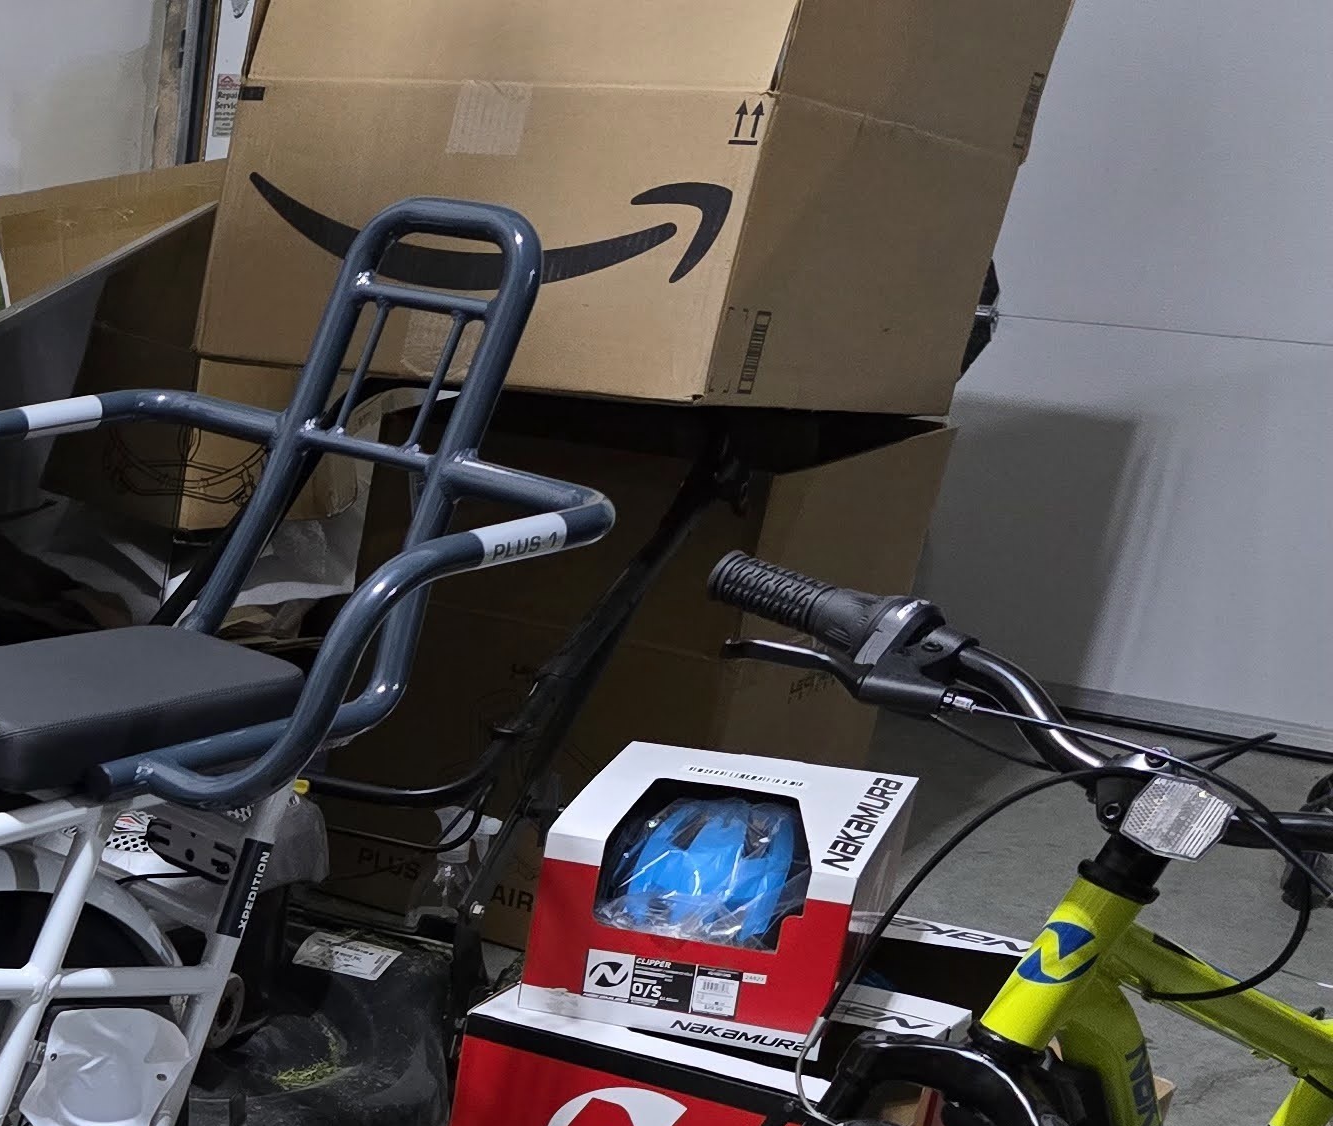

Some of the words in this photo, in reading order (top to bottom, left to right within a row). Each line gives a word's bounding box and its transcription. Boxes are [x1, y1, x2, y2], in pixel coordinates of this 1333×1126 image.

[493, 536, 541, 560] PLUS
[548, 531, 558, 548] 1
[238, 851, 271, 933] XPEDITION
[635, 957, 672, 969] CLIPPER
